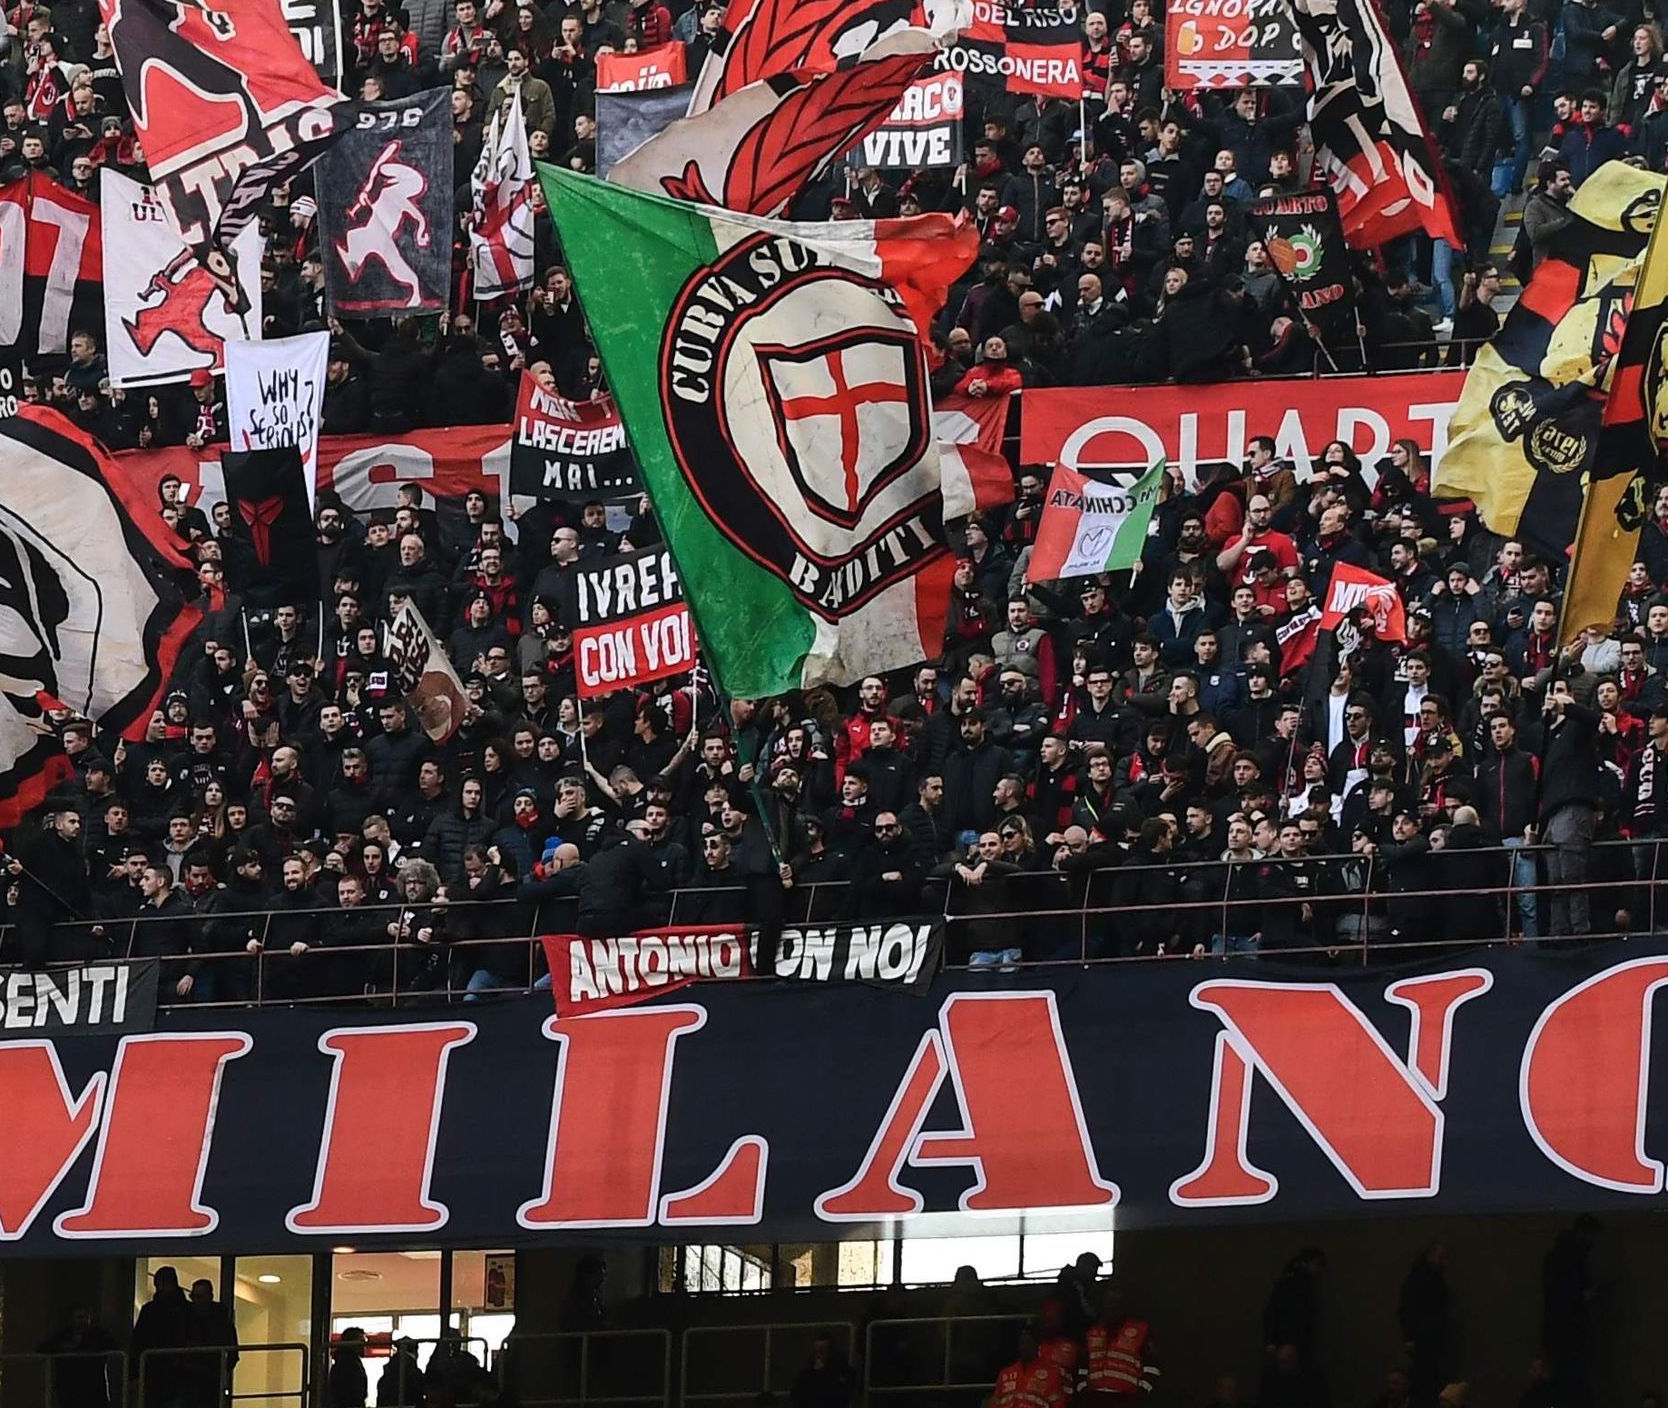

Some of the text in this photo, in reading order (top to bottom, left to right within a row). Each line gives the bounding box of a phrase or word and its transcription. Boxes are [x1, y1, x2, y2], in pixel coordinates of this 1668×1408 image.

[934, 45, 1081, 84] ROSSONERA
[257, 368, 299, 405] WHY
[273, 404, 288, 426] SO
[579, 610, 691, 687] CON VOI
[569, 924, 933, 1002] ANTONIO ON NOI
